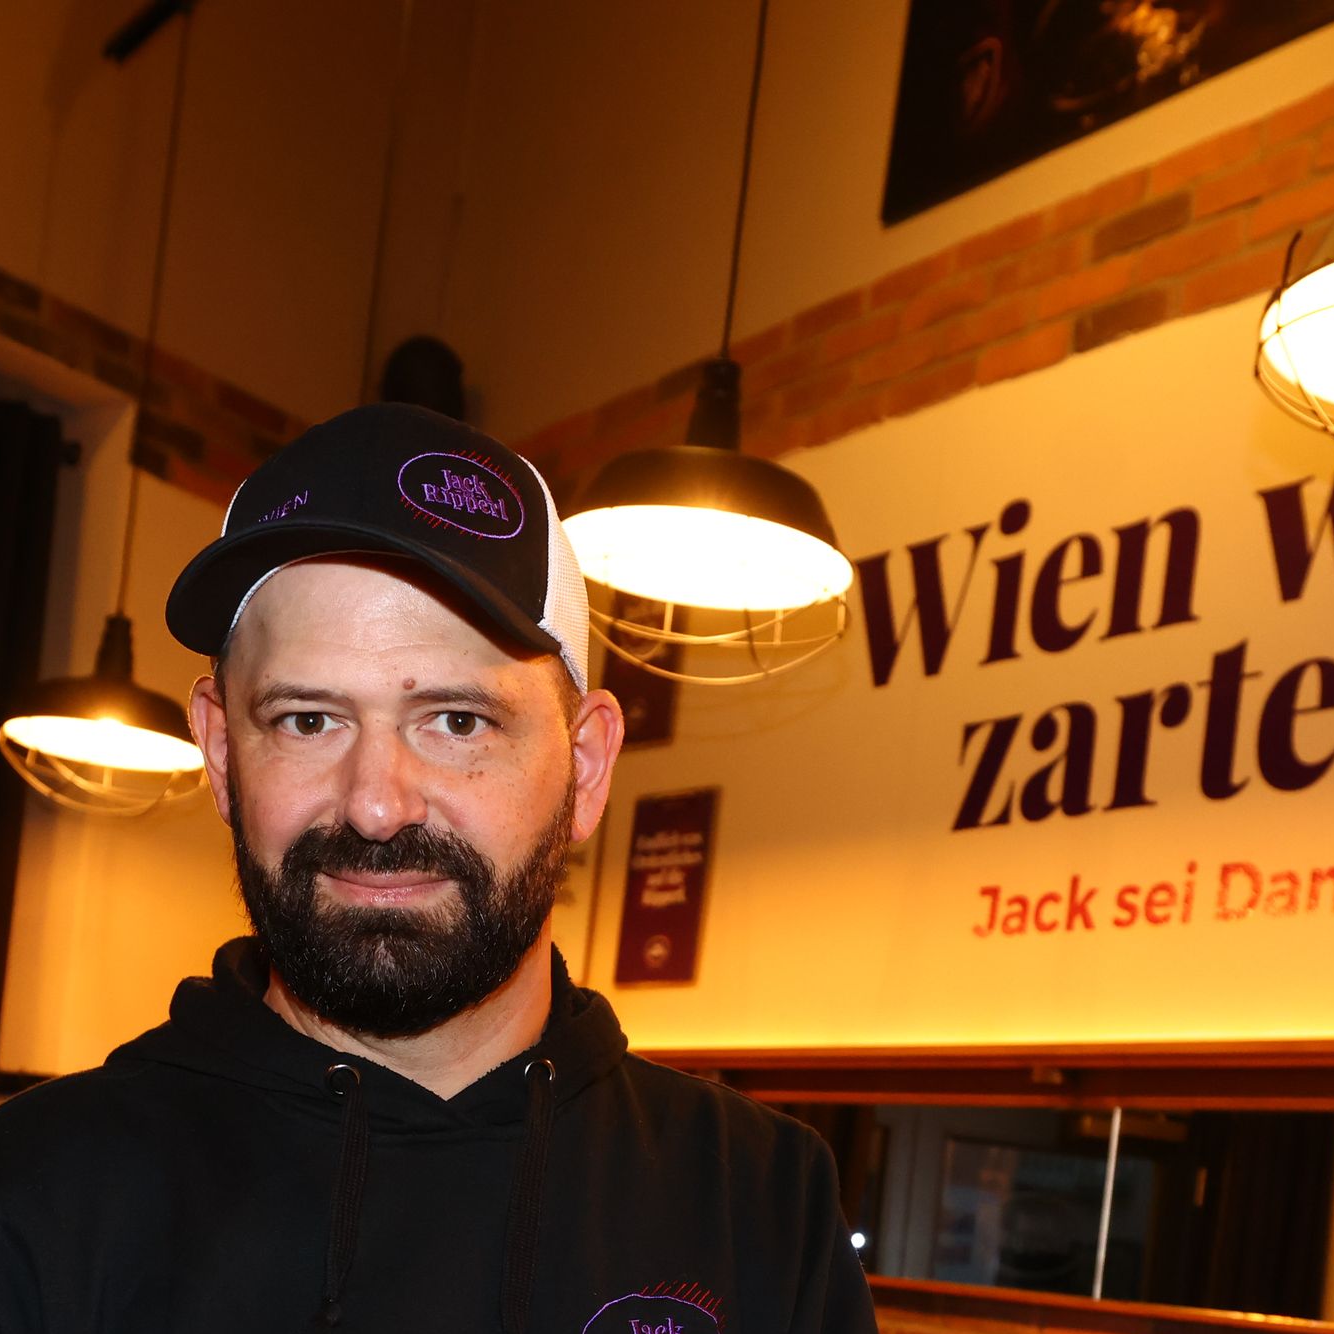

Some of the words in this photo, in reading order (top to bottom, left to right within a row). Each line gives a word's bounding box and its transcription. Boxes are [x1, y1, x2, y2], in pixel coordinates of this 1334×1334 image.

[421, 483, 509, 521] Ripperl
[441, 469, 492, 500] Jack
[856, 497, 1204, 689] Wien
[971, 873, 1099, 938] Jack
[1112, 859, 1199, 929] sei
